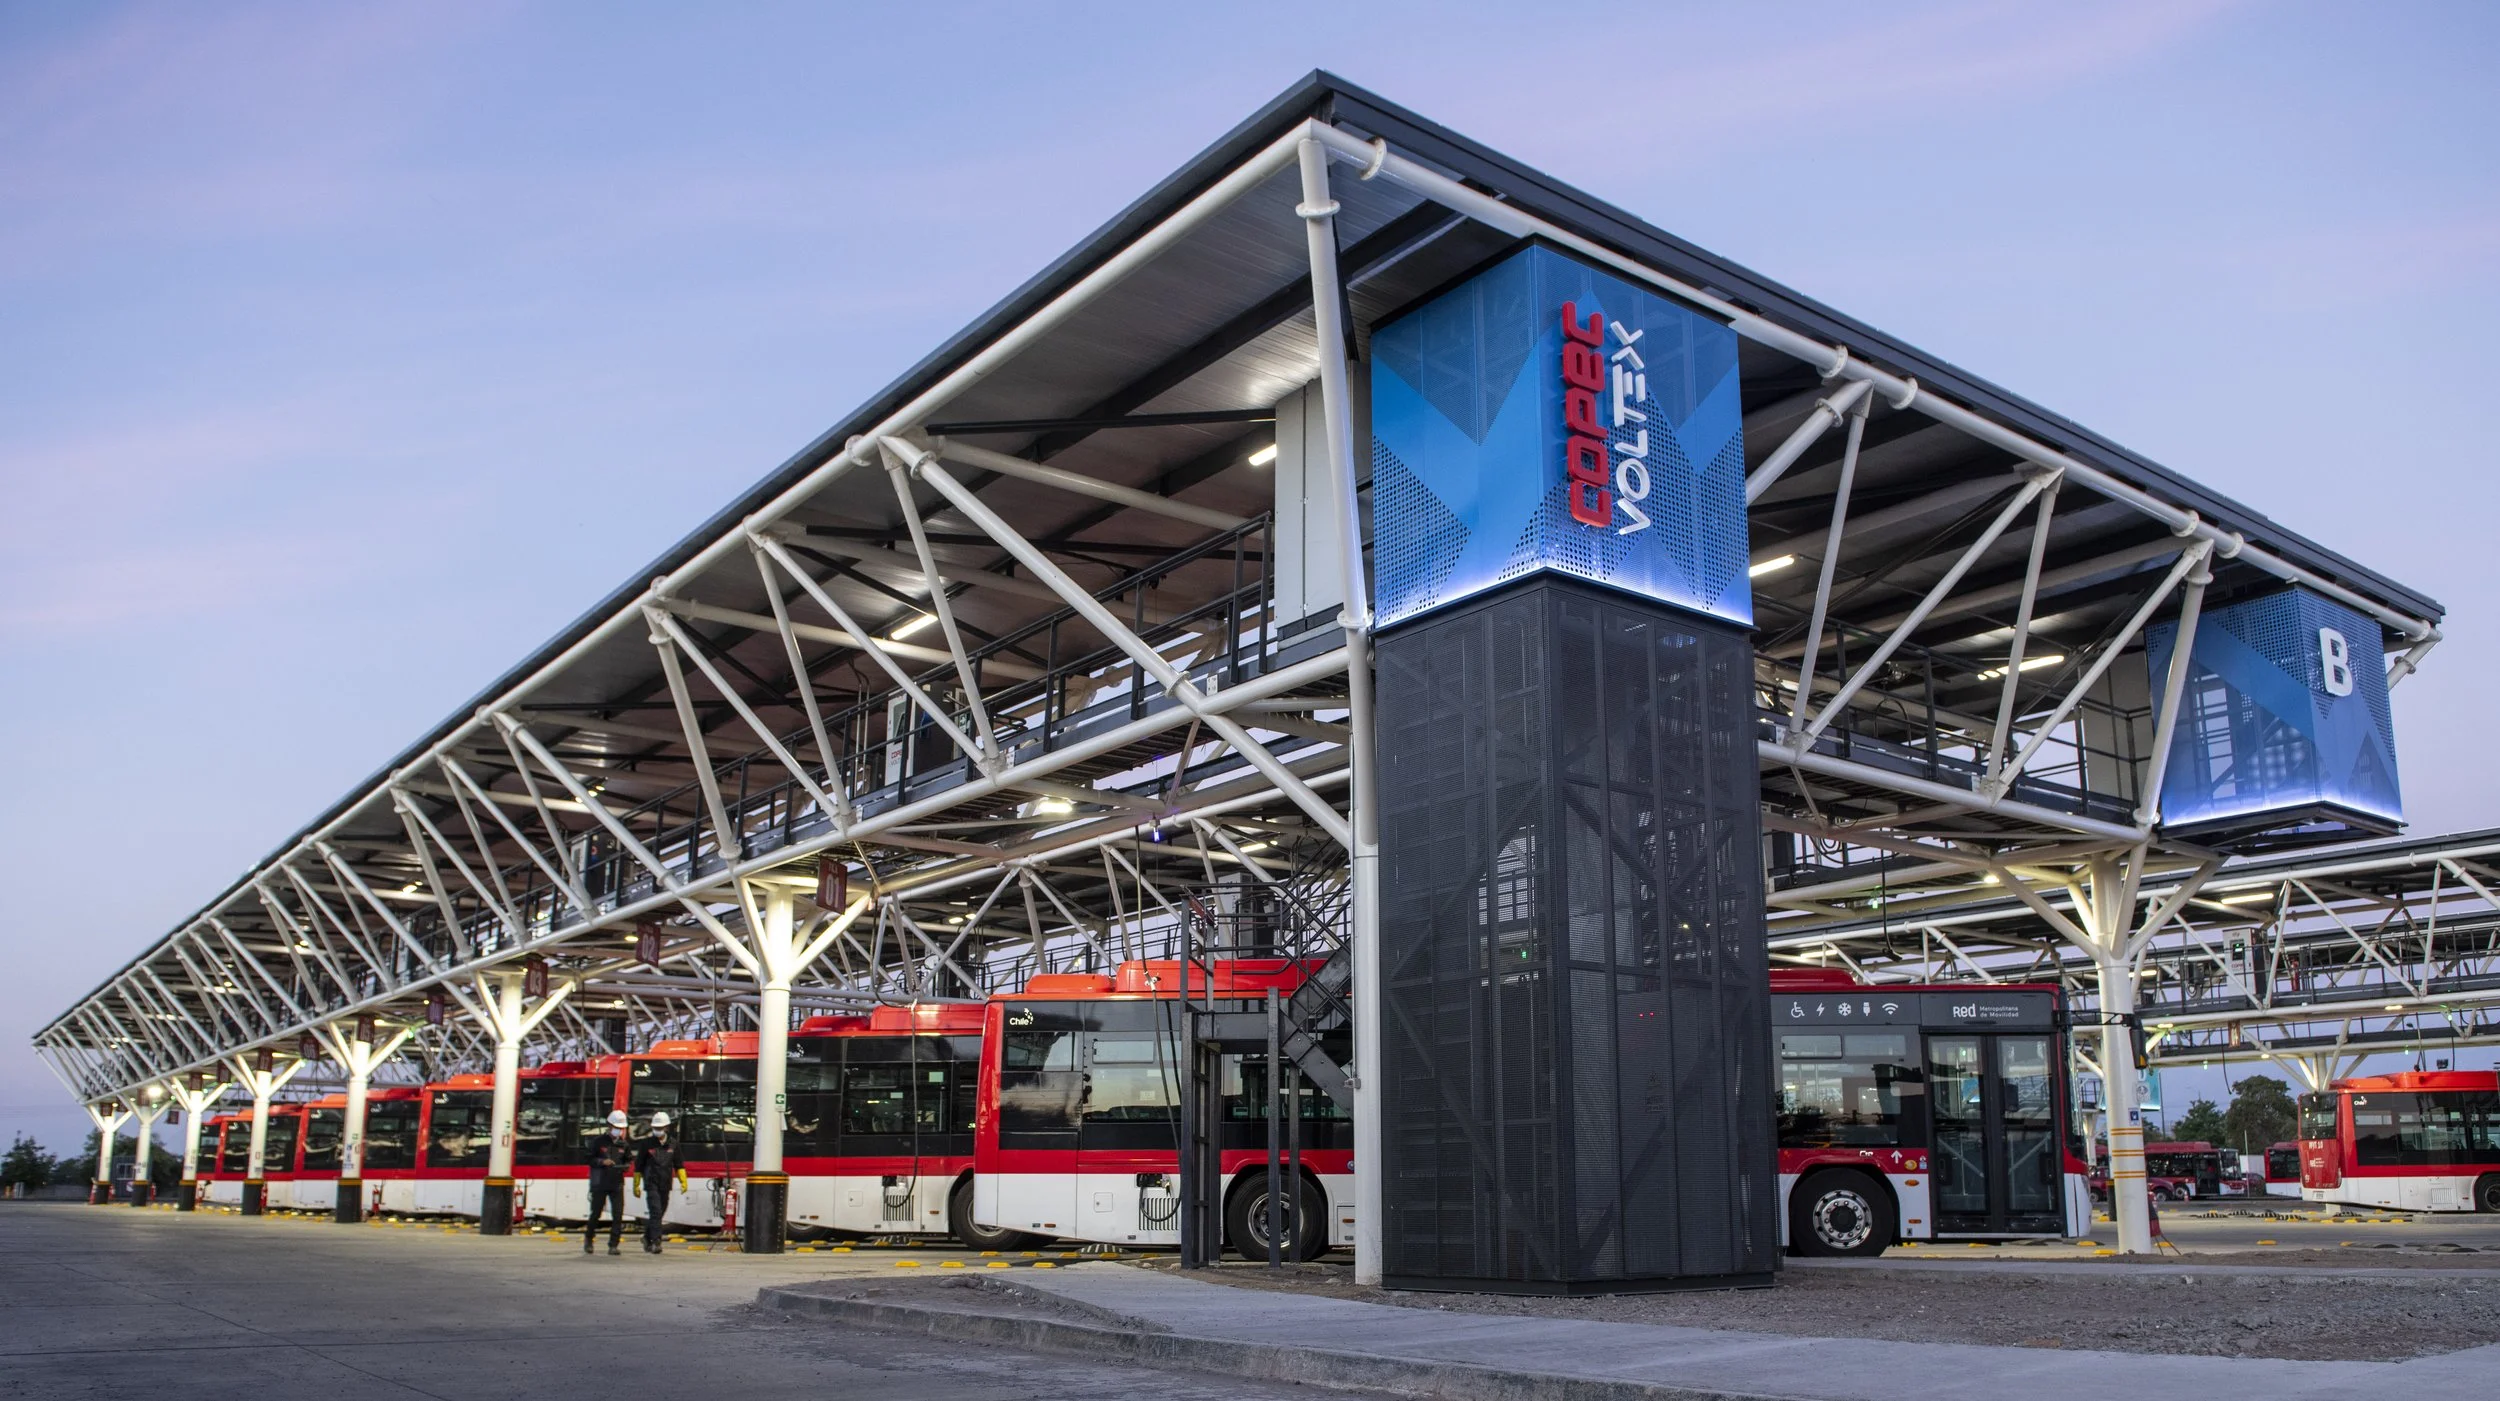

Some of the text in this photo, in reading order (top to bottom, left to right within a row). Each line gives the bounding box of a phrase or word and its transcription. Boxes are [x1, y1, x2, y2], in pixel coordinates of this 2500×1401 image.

[1561, 300, 1613, 528] COPEC
[1610, 319, 1652, 536] VOLTEX
[2319, 626, 2354, 697] B
[825, 873, 840, 908] 01
[641, 932, 656, 963] 02
[1009, 1017, 1030, 1026] Chile
[1952, 1003, 1977, 1018] Red
